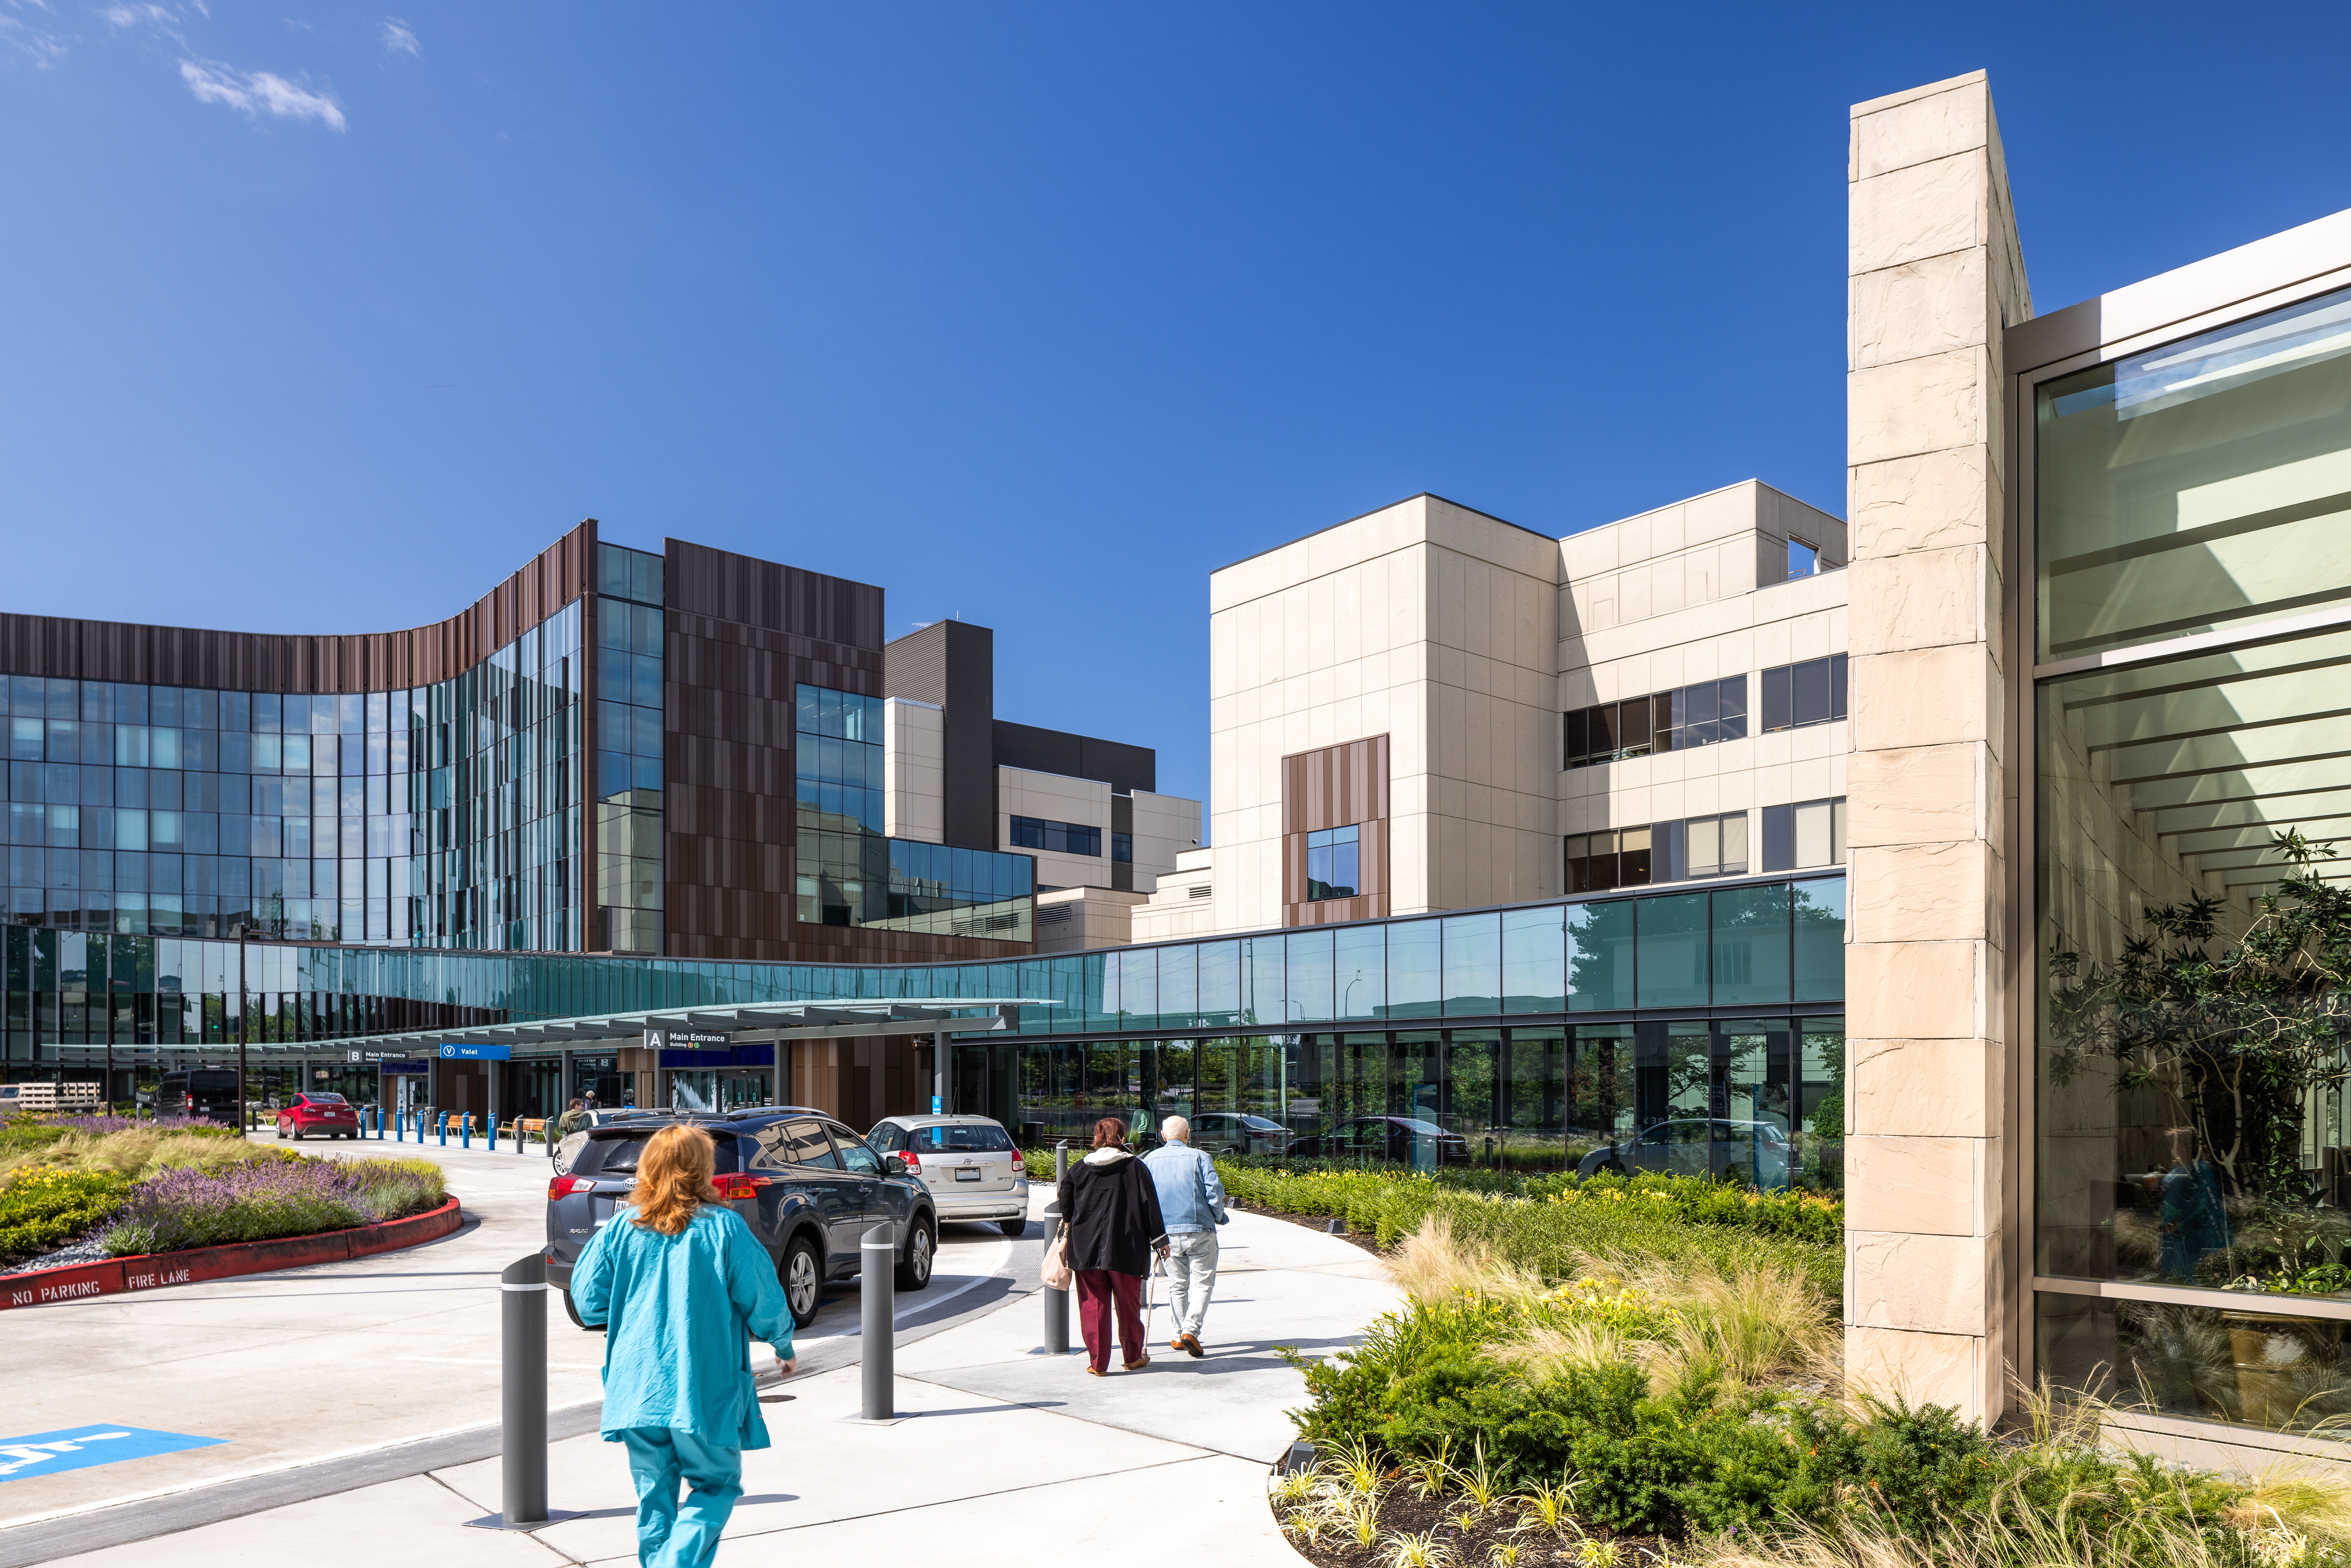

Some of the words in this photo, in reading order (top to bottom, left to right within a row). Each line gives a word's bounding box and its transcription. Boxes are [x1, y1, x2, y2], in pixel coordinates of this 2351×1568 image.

[649, 1032, 662, 1047] A
[670, 1032, 689, 1041] Main
[690, 1033, 725, 1042] Entrance
[352, 1051, 360, 1061] B
[13, 1290, 33, 1305] NO
[41, 1281, 100, 1301] PARKING
[128, 1273, 156, 1289] FIRE
[160, 1269, 190, 1284] LANE
